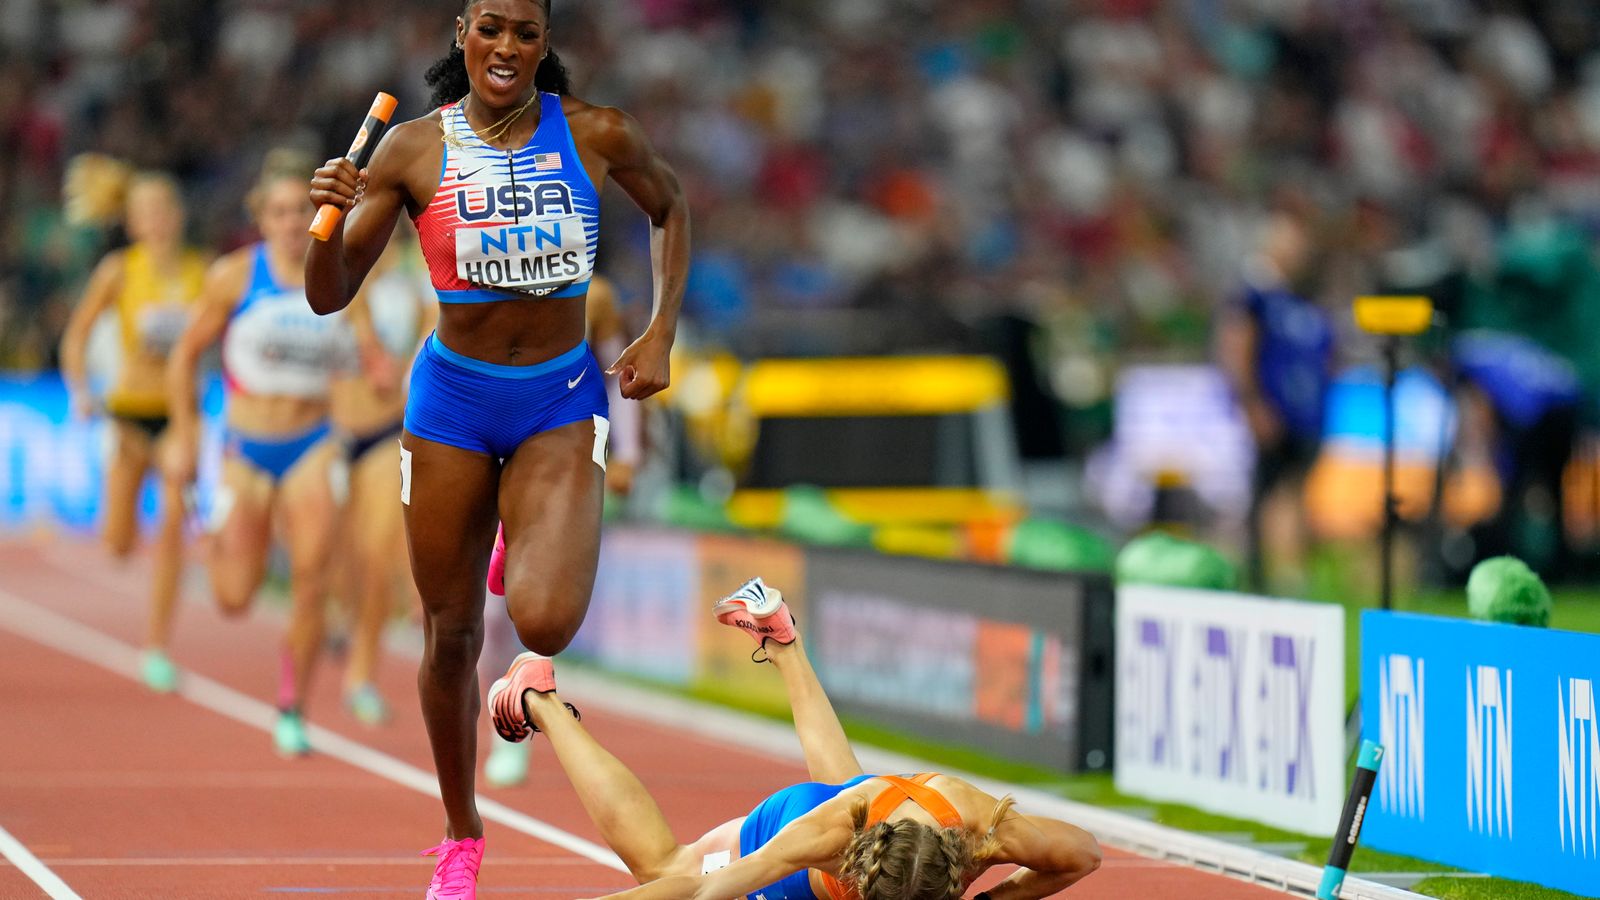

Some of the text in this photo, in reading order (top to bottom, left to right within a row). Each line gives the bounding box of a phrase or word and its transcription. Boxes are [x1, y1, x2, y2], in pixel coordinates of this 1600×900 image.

[456, 182, 573, 222] USA
[480, 222, 562, 256] NTN
[465, 250, 581, 285] HOLMES
[1379, 653, 1425, 823] NTN
[1466, 664, 1513, 842] NTN
